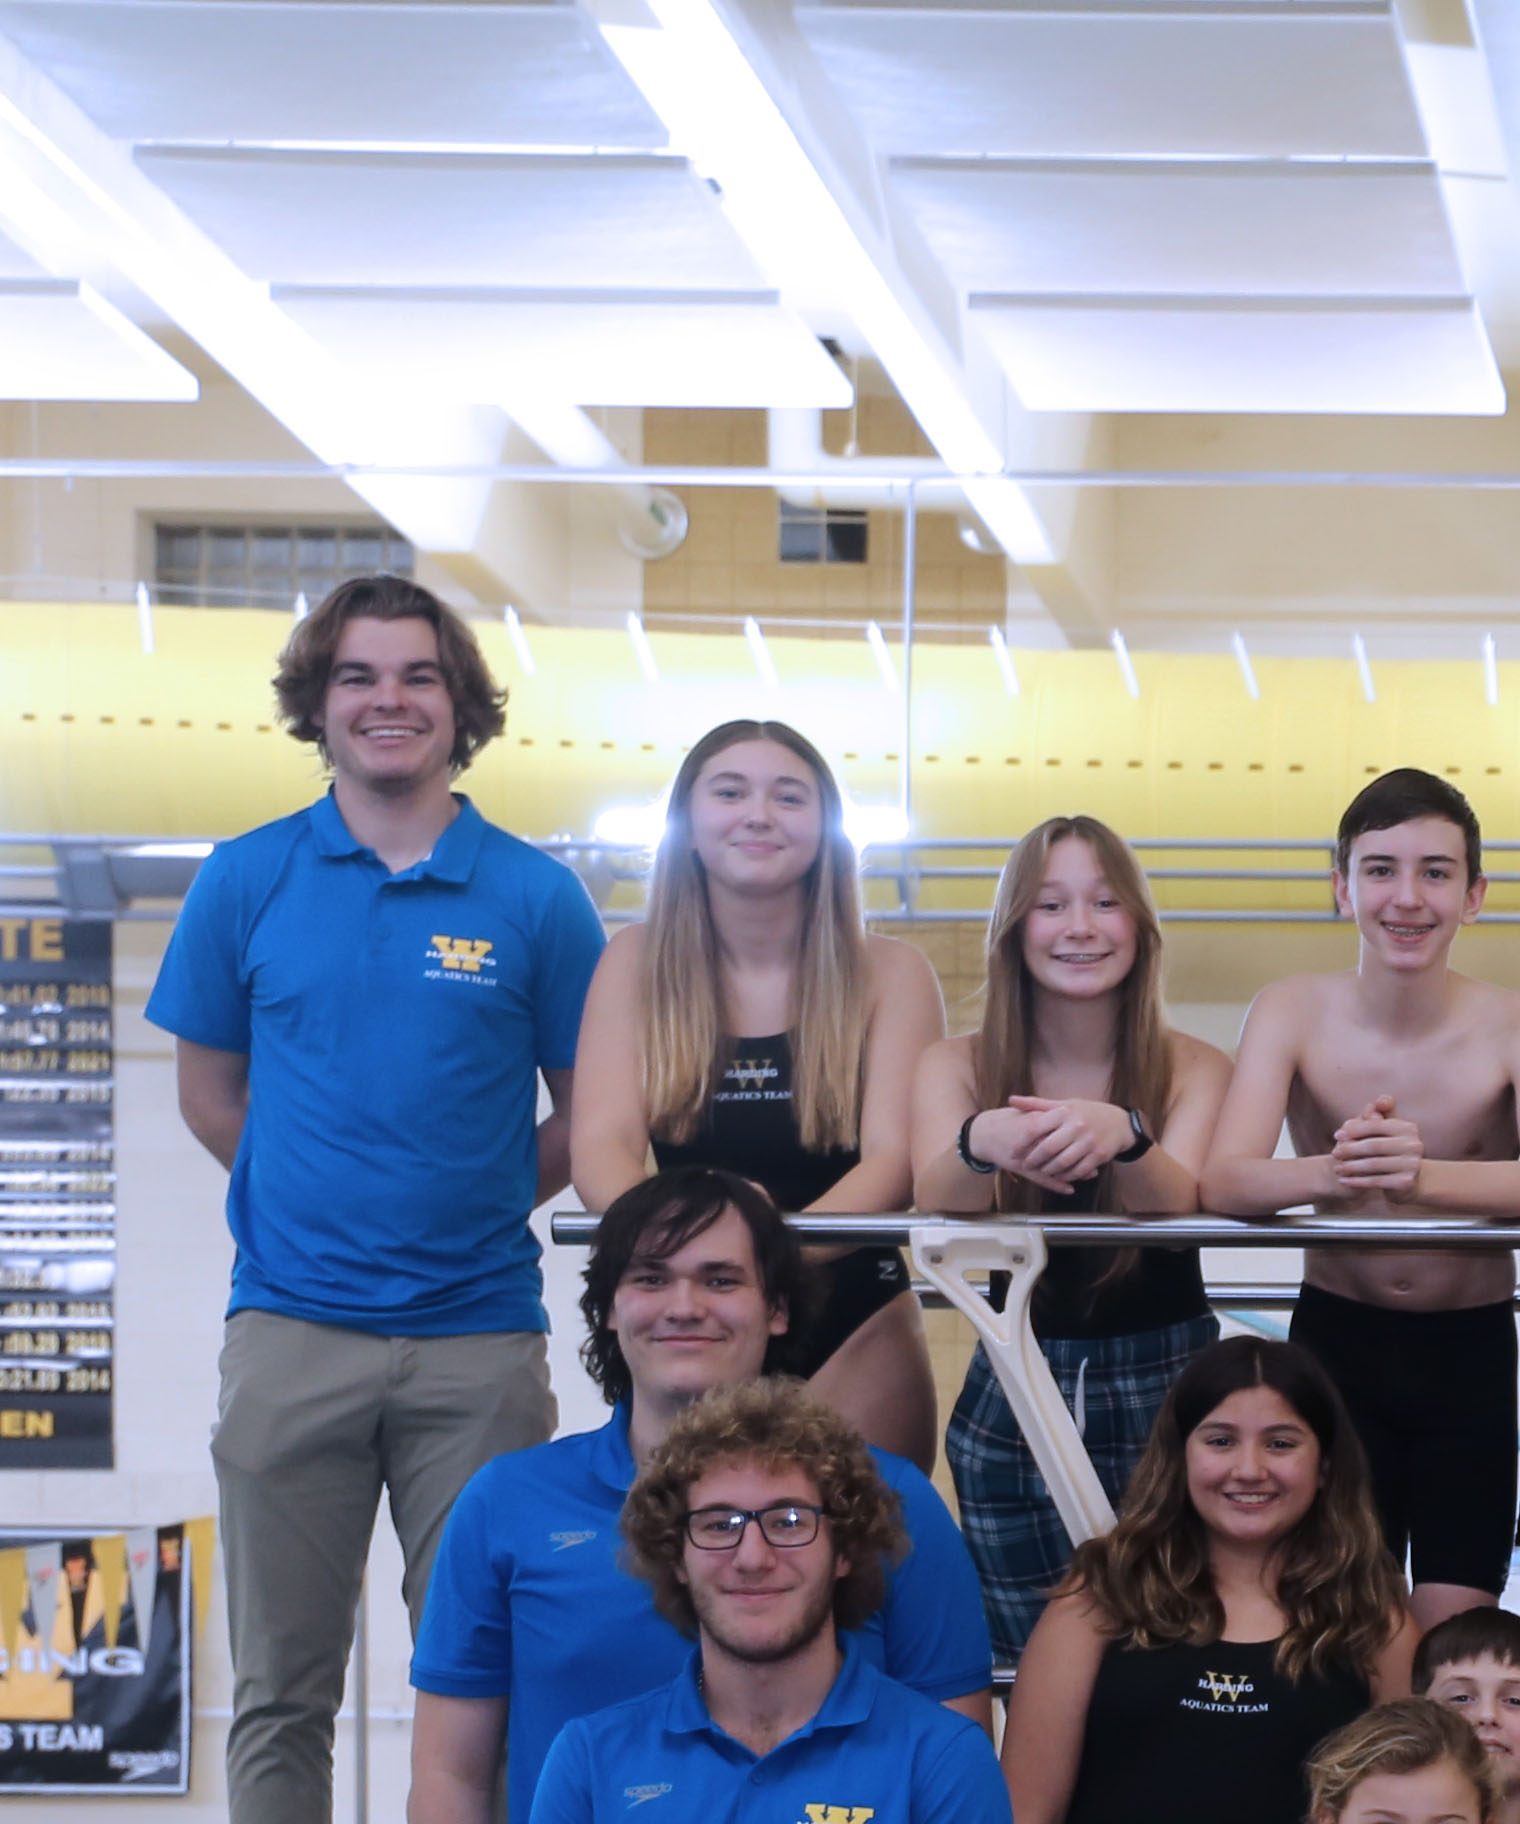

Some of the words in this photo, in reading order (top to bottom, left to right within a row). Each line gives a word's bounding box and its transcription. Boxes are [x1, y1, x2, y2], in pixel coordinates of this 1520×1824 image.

[1198, 1678, 1254, 1693] HARDING
[1179, 1698, 1235, 1713] AQUATICS
[1236, 1703, 1269, 1713] TEAM
[20, 1724, 103, 1750] TEAM
